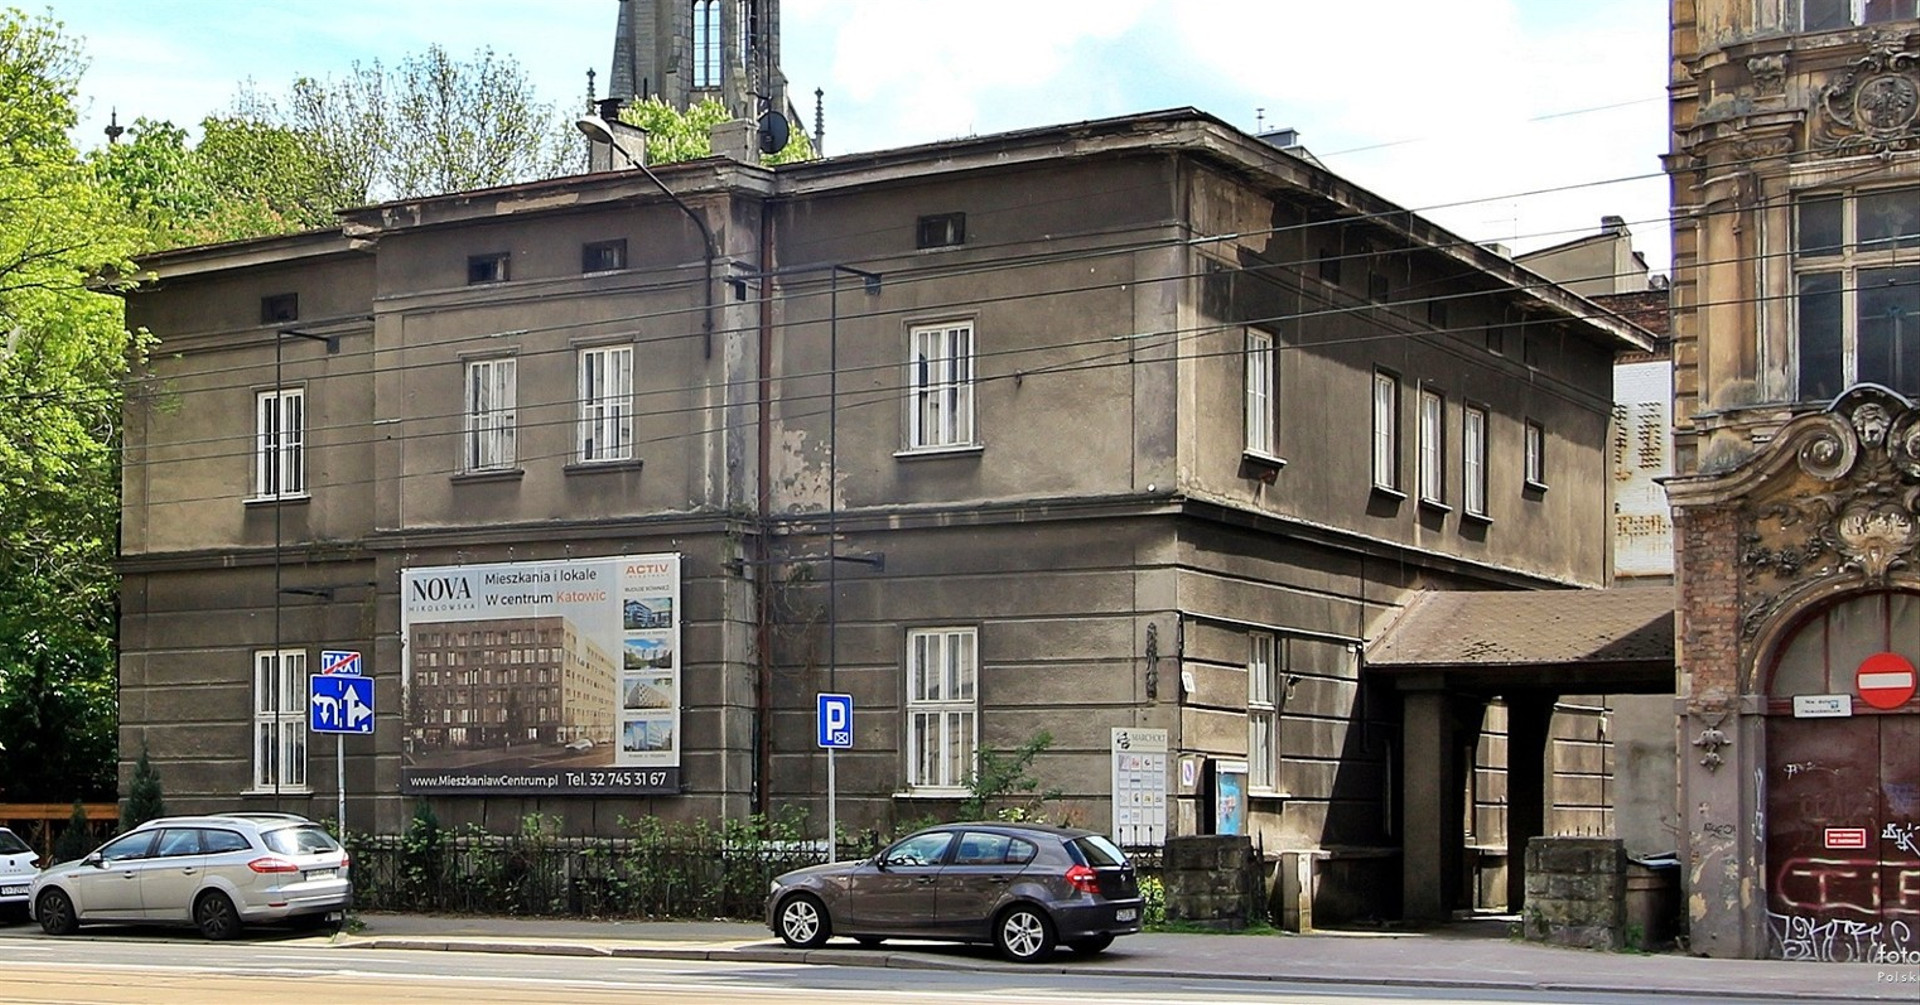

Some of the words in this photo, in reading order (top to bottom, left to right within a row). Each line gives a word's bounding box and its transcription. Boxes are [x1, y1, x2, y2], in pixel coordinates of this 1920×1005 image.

[485, 570, 551, 585] Mieszkania
[554, 570, 557, 581] i
[560, 568, 597, 581] lokale
[626, 563, 669, 575] ACTIV
[412, 577, 471, 601] NOVA
[485, 594, 499, 606] W
[500, 593, 554, 605] centrum
[556, 588, 606, 603] Katowic
[323, 654, 358, 673] TAXI
[827, 701, 845, 741] P
[410, 774, 558, 788] www.MieszkaniawCentrum.pl
[565, 772, 587, 786] Tel.
[589, 772, 605, 786] 32
[608, 772, 631, 786] 745
[634, 772, 646, 786] 31
[650, 772, 666, 786] 67
